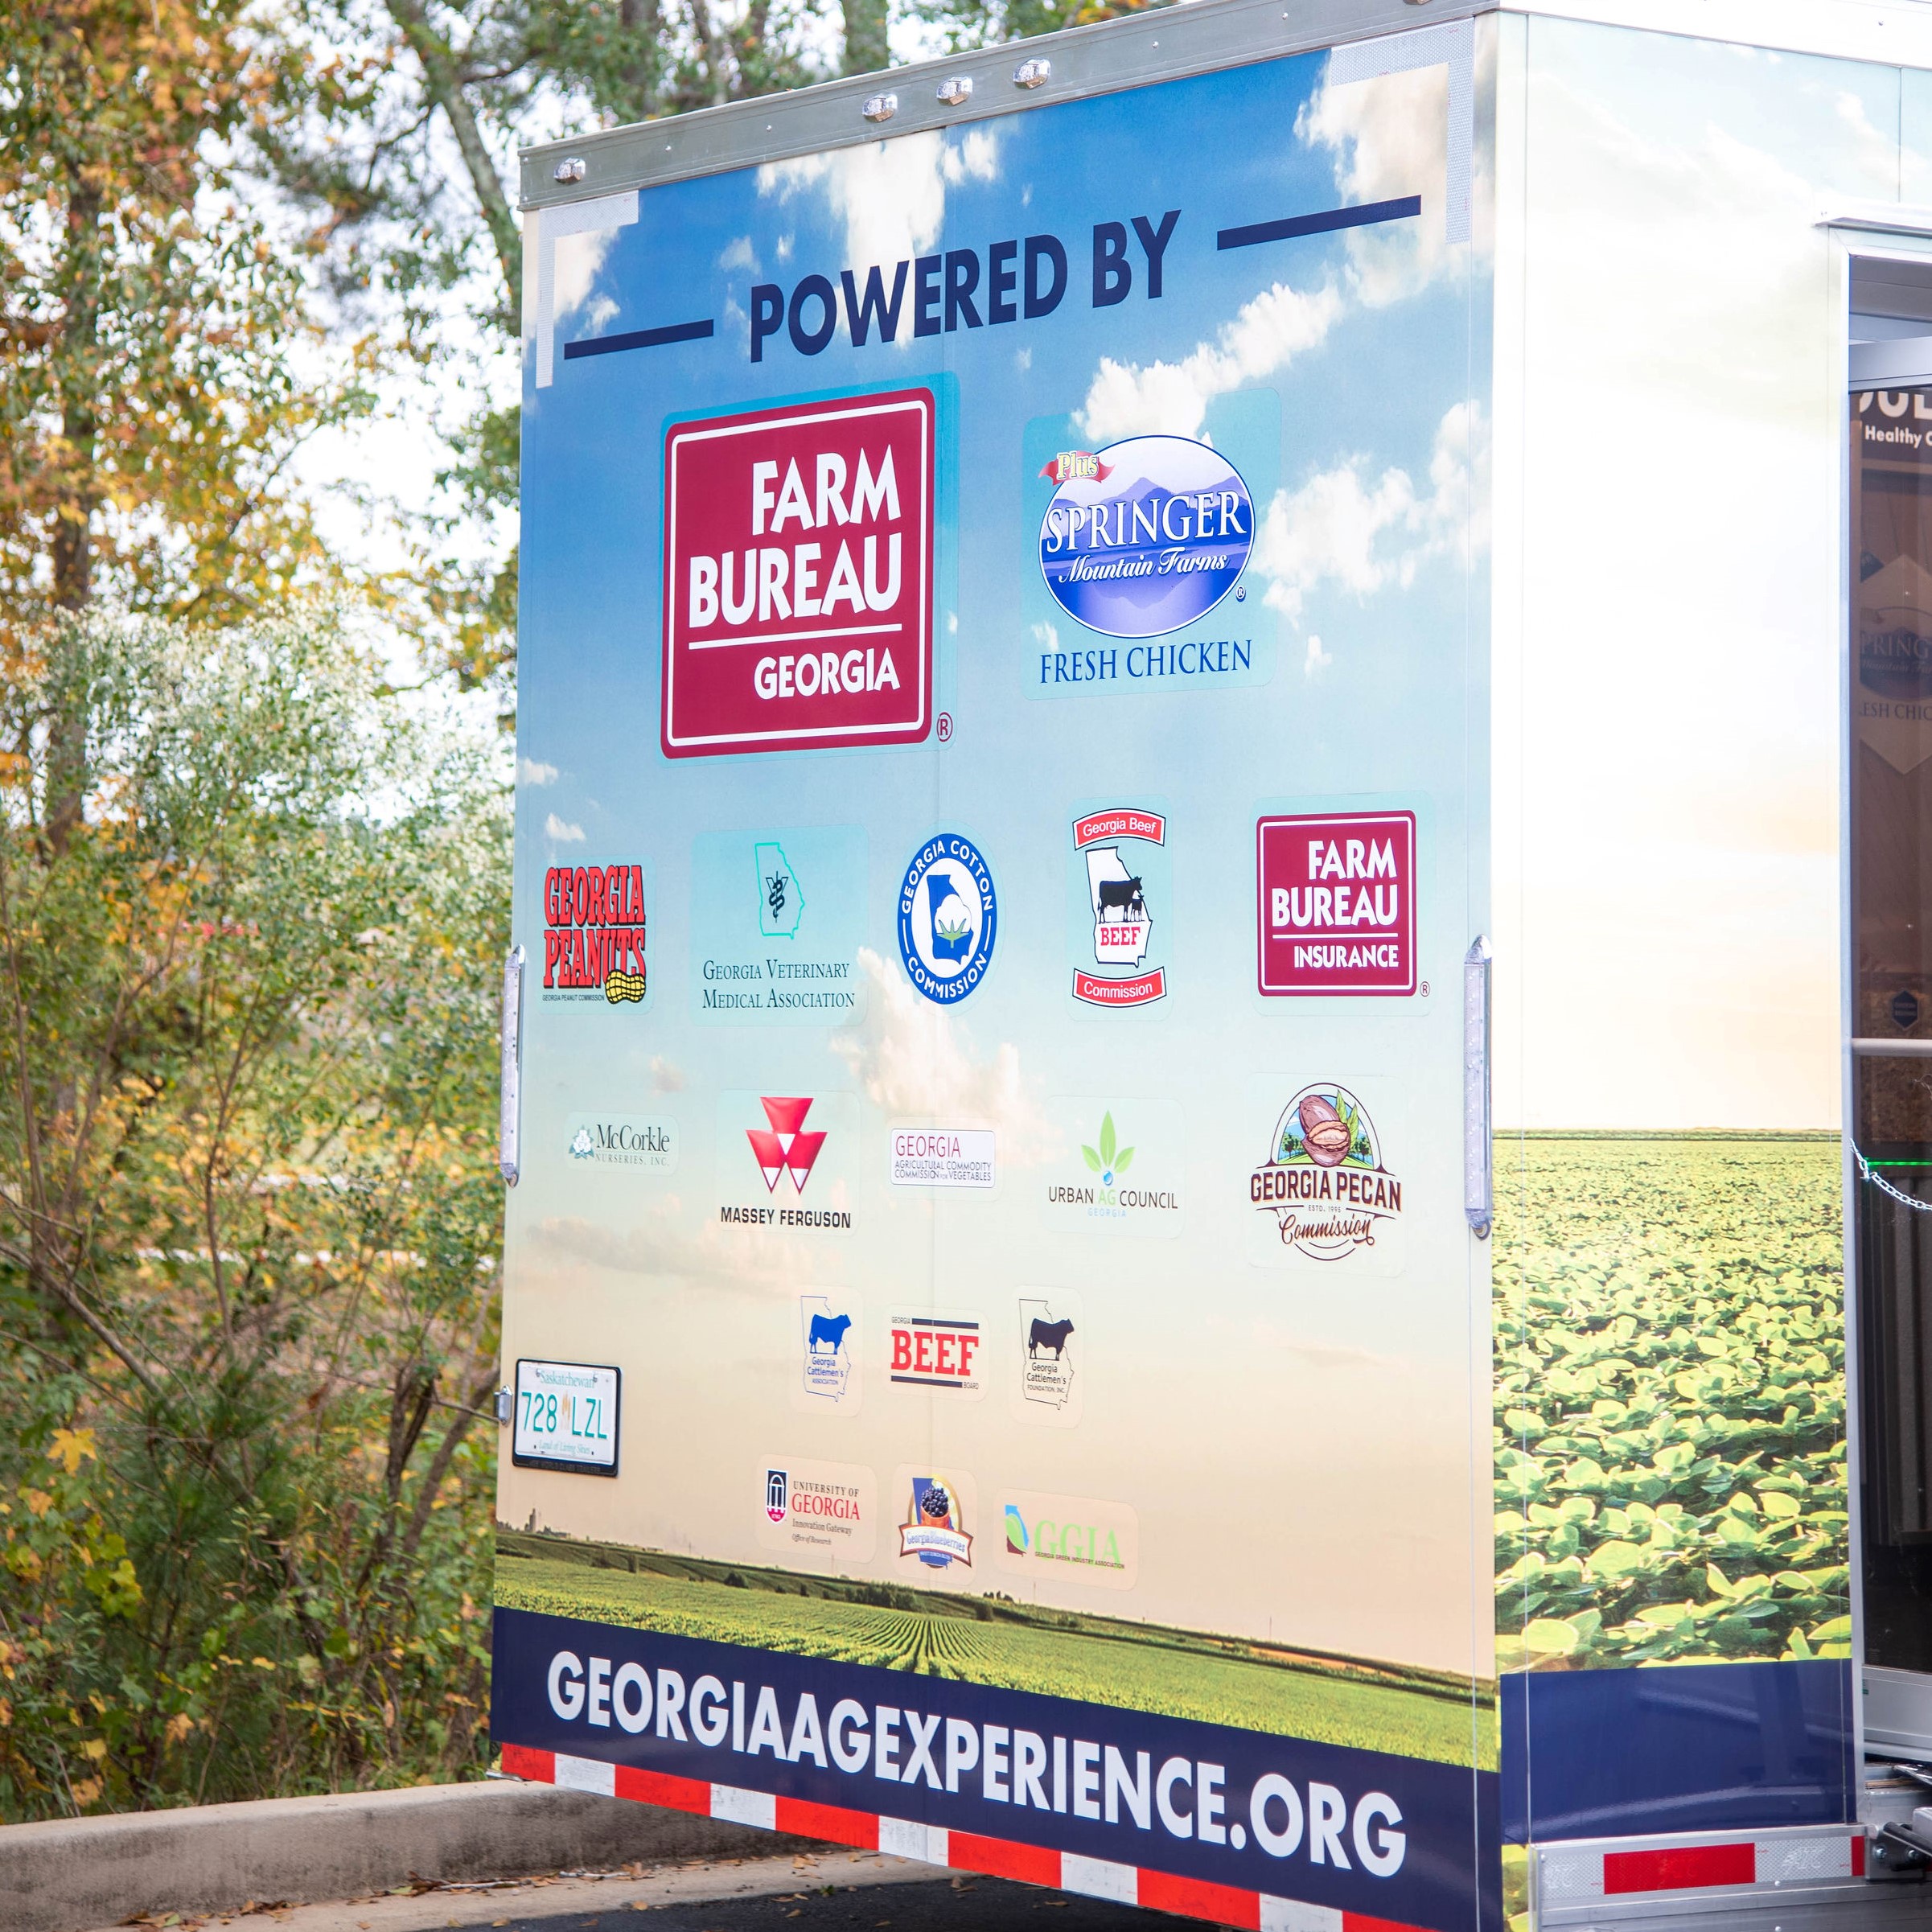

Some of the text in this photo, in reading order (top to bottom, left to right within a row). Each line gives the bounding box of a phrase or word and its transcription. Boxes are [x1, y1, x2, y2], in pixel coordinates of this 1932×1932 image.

[750, 210, 1182, 363] POWERED BY
[1865, 425, 1922, 449] Healthy
[1056, 450, 1099, 479] Plus
[752, 444, 900, 536] FARM
[1046, 491, 1247, 553] SPRINGER
[1058, 546, 1231, 583] Mountain Farms
[688, 532, 902, 630] BUREAU
[753, 647, 900, 700] GEORGIA
[1040, 639, 1252, 684] FRESH CHICKEN
[1083, 819, 1157, 837] Georgia Beef
[1308, 837, 1397, 880] FARM
[902, 840, 993, 915] GEORGIA COTTON
[544, 865, 646, 927] GEORGIA
[1272, 884, 1398, 928] BUREAU
[1100, 927, 1141, 947] BEEF
[543, 928, 647, 989] PEANUTS
[1293, 944, 1400, 968] INSURANCE
[703, 959, 849, 980] GEORGIA VETERINARY
[907, 953, 987, 999] COMMISSION
[702, 989, 855, 1009] MEDICAL ASSOCIATION
[1083, 980, 1153, 999] Commission
[596, 1124, 670, 1153] McCorkle
[895, 1135, 961, 1158] GEORGIA
[650, 1157, 670, 1166] INC.
[894, 1159, 992, 1171] AGRICULTURAL COMMODITY
[894, 1169, 939, 1179] COMMISSION
[948, 1171, 992, 1182] VEGETABLES
[1049, 1186, 1178, 1209] URBAN AG COUNCIL
[1251, 1170, 1402, 1213] GEORGIA PECAN
[721, 1206, 851, 1229] MASSEY FERGUSON
[1087, 1207, 1127, 1218] GEORGIA
[1279, 1214, 1375, 1246] Commission
[812, 1356, 837, 1368] Georgia
[890, 1329, 980, 1376] BEEF
[540, 1370, 595, 1389] Saskatchewan
[807, 1367, 845, 1378] Cattlemen's
[1026, 1372, 1067, 1385] Cattlemen's
[1031, 1362, 1058, 1375] Georgia
[521, 1391, 608, 1440] 728 LZL
[793, 1481, 860, 1498] UNIVERSITY OF
[791, 1493, 861, 1520] GEORGIA
[792, 1519, 853, 1536] Innovation Gateway
[1034, 1519, 1123, 1570] GGIA
[1034, 1551, 1125, 1569] GEORGIA GREEN INDUSTRY ASSOCIATION
[547, 1650, 1408, 1879] GEORGIAAGEXPERIENCE.ORG
